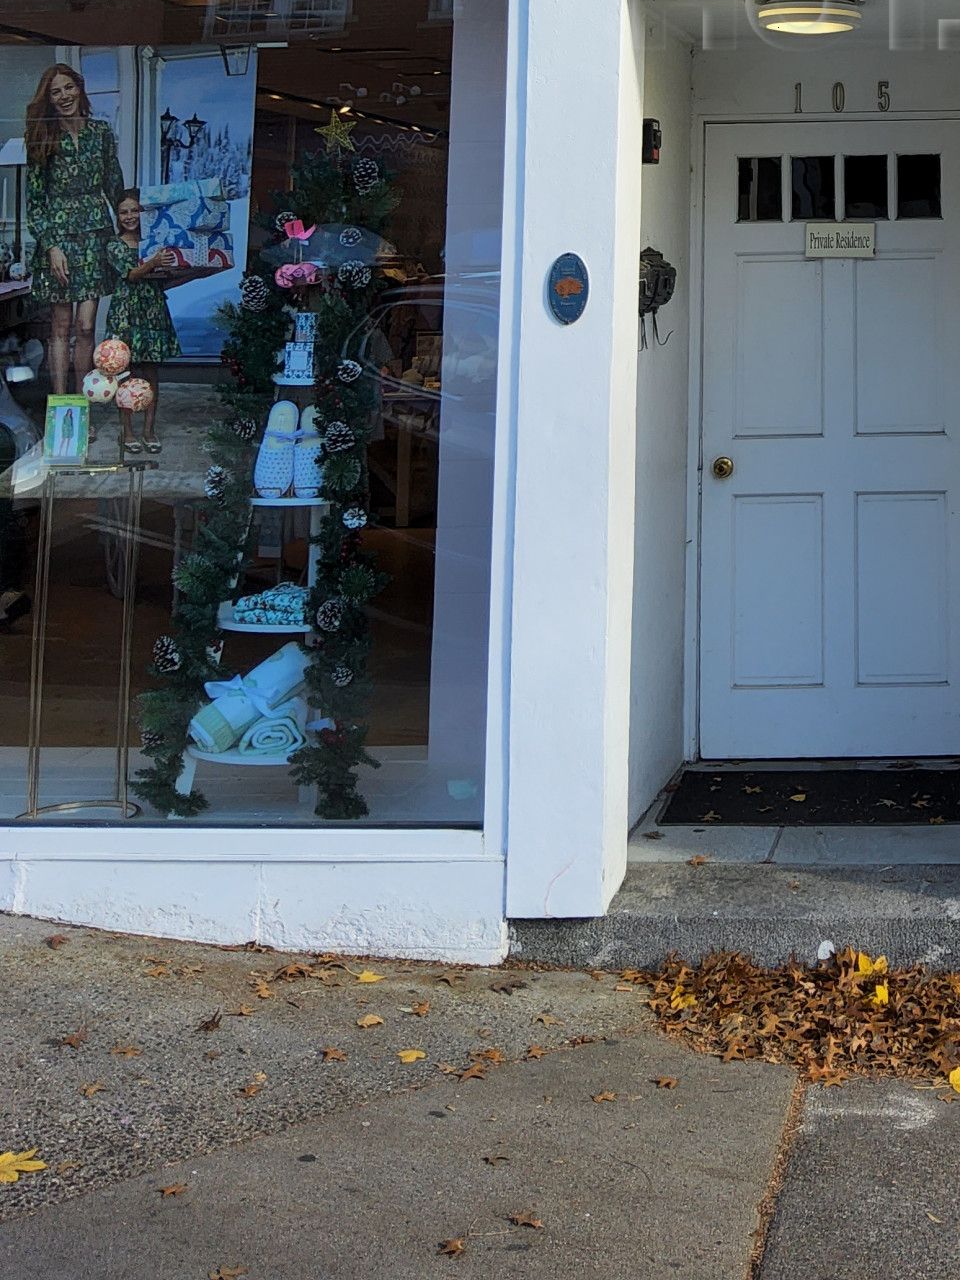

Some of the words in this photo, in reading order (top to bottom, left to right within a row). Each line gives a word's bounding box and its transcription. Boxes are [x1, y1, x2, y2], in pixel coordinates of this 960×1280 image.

[794, 81, 891, 113] 105
[809, 231, 834, 249] Private
[836, 230, 871, 249] Residence
